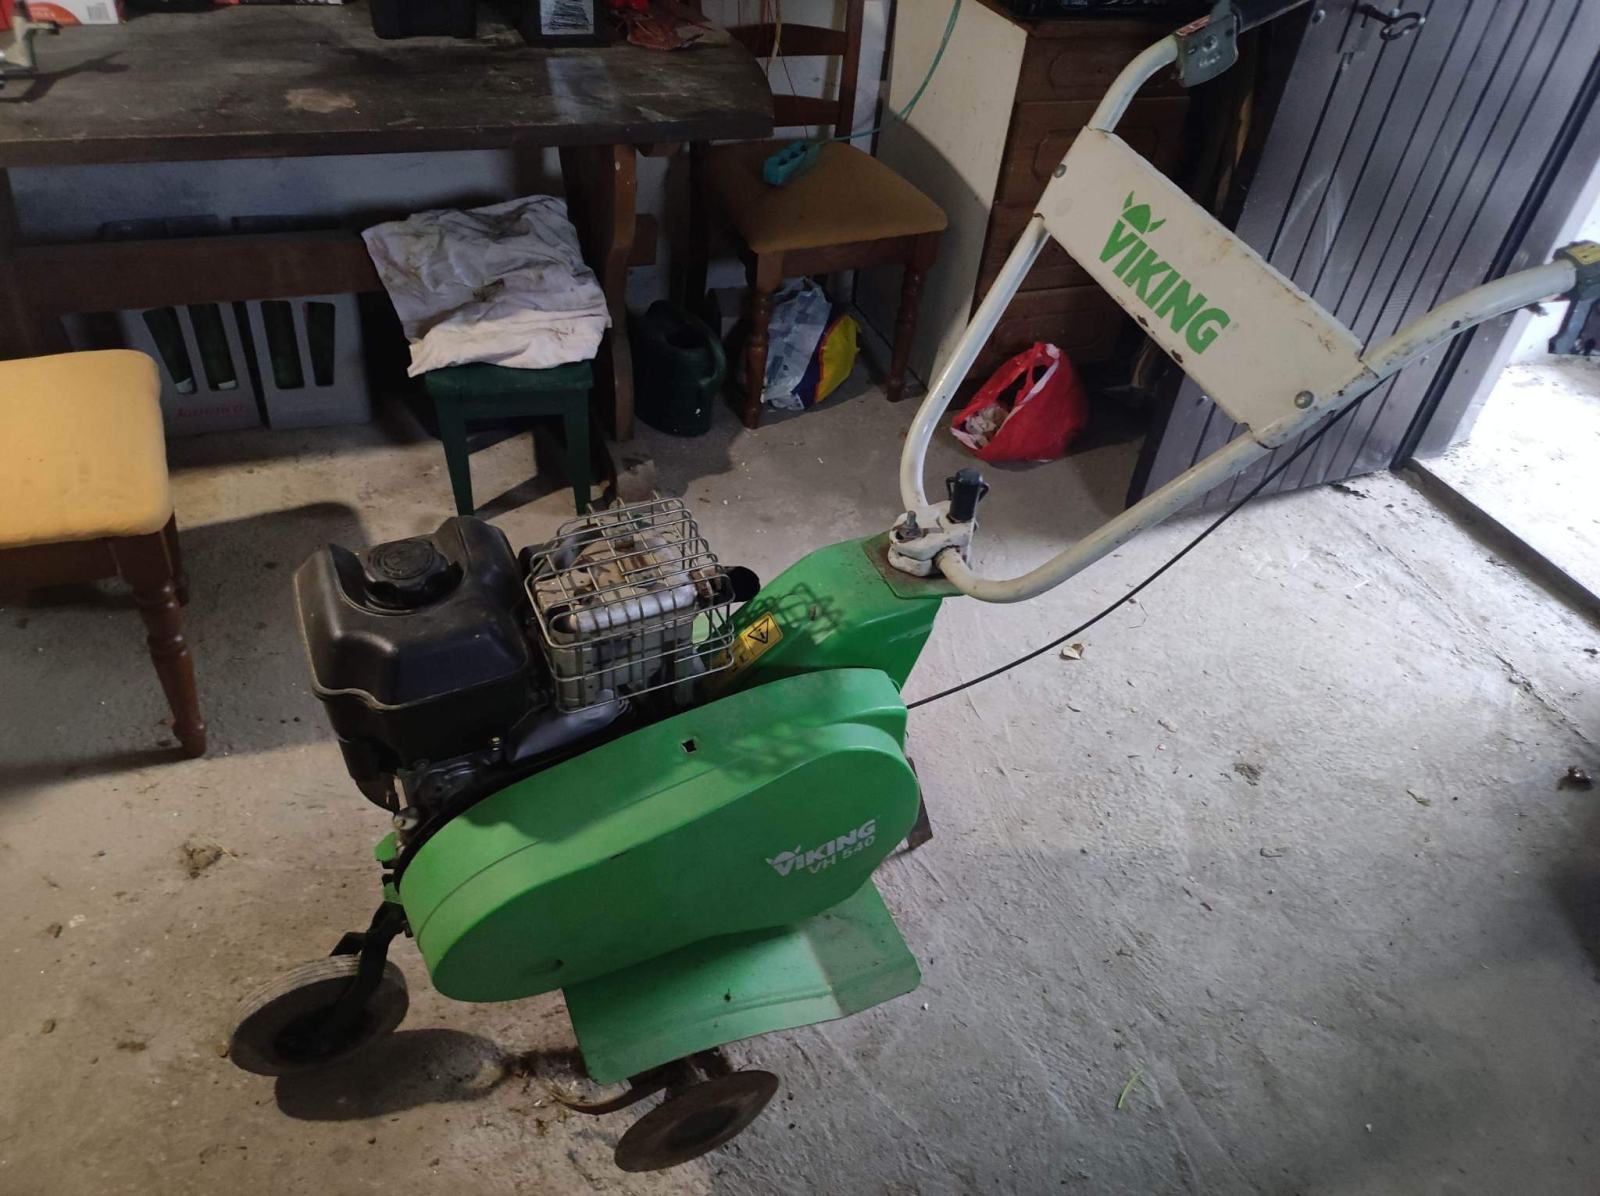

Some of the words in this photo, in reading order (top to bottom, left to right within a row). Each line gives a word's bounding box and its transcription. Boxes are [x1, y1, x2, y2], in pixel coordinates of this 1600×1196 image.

[1099, 219, 1231, 355] VIKING
[773, 819, 876, 876] VIKING
[809, 855, 836, 874] VH
